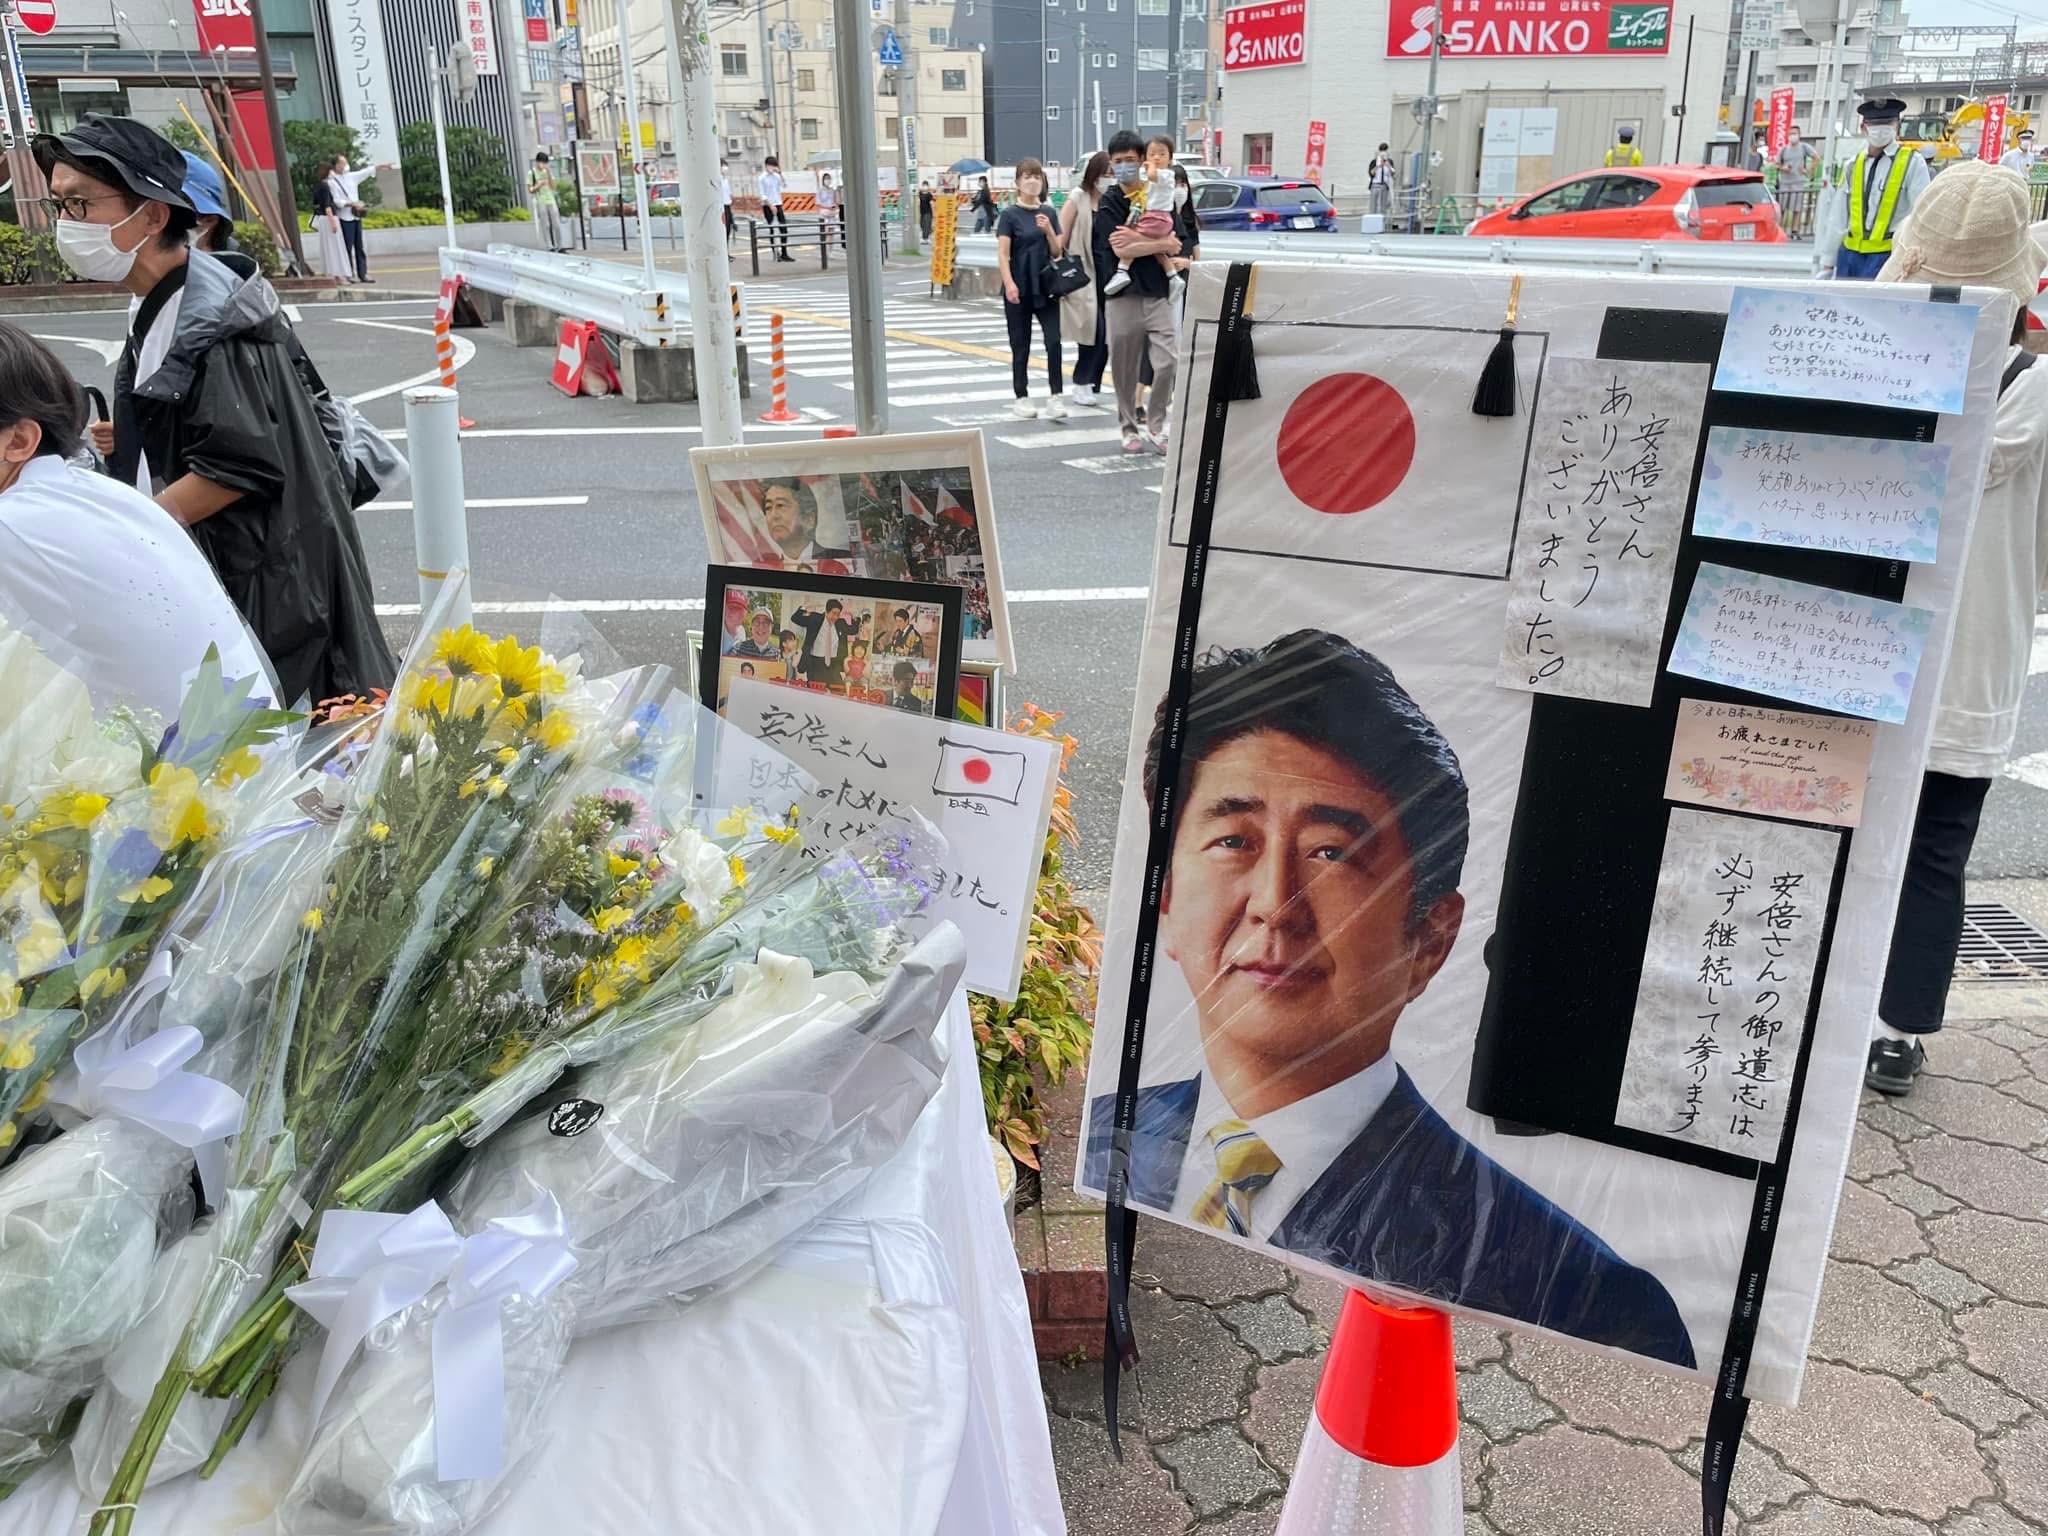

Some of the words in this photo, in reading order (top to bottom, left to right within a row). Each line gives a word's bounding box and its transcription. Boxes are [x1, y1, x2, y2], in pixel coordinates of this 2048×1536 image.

[467, 0, 489, 70] 南都銀行
[1239, 32, 1303, 63] SANKO
[1451, 19, 1590, 52] SANKO
[1608, 7, 1669, 38] エイブル
[1573, 375, 1633, 609] ありがとう
[1619, 412, 1671, 561] 安倍さん
[756, 705, 888, 769] 安倍さん
[1717, 724, 1829, 752] お疲れさまでした
[1666, 853, 1754, 1133] 必ず継続して参ります
[1730, 872, 1804, 1138] 安倍さんの御遺志は
